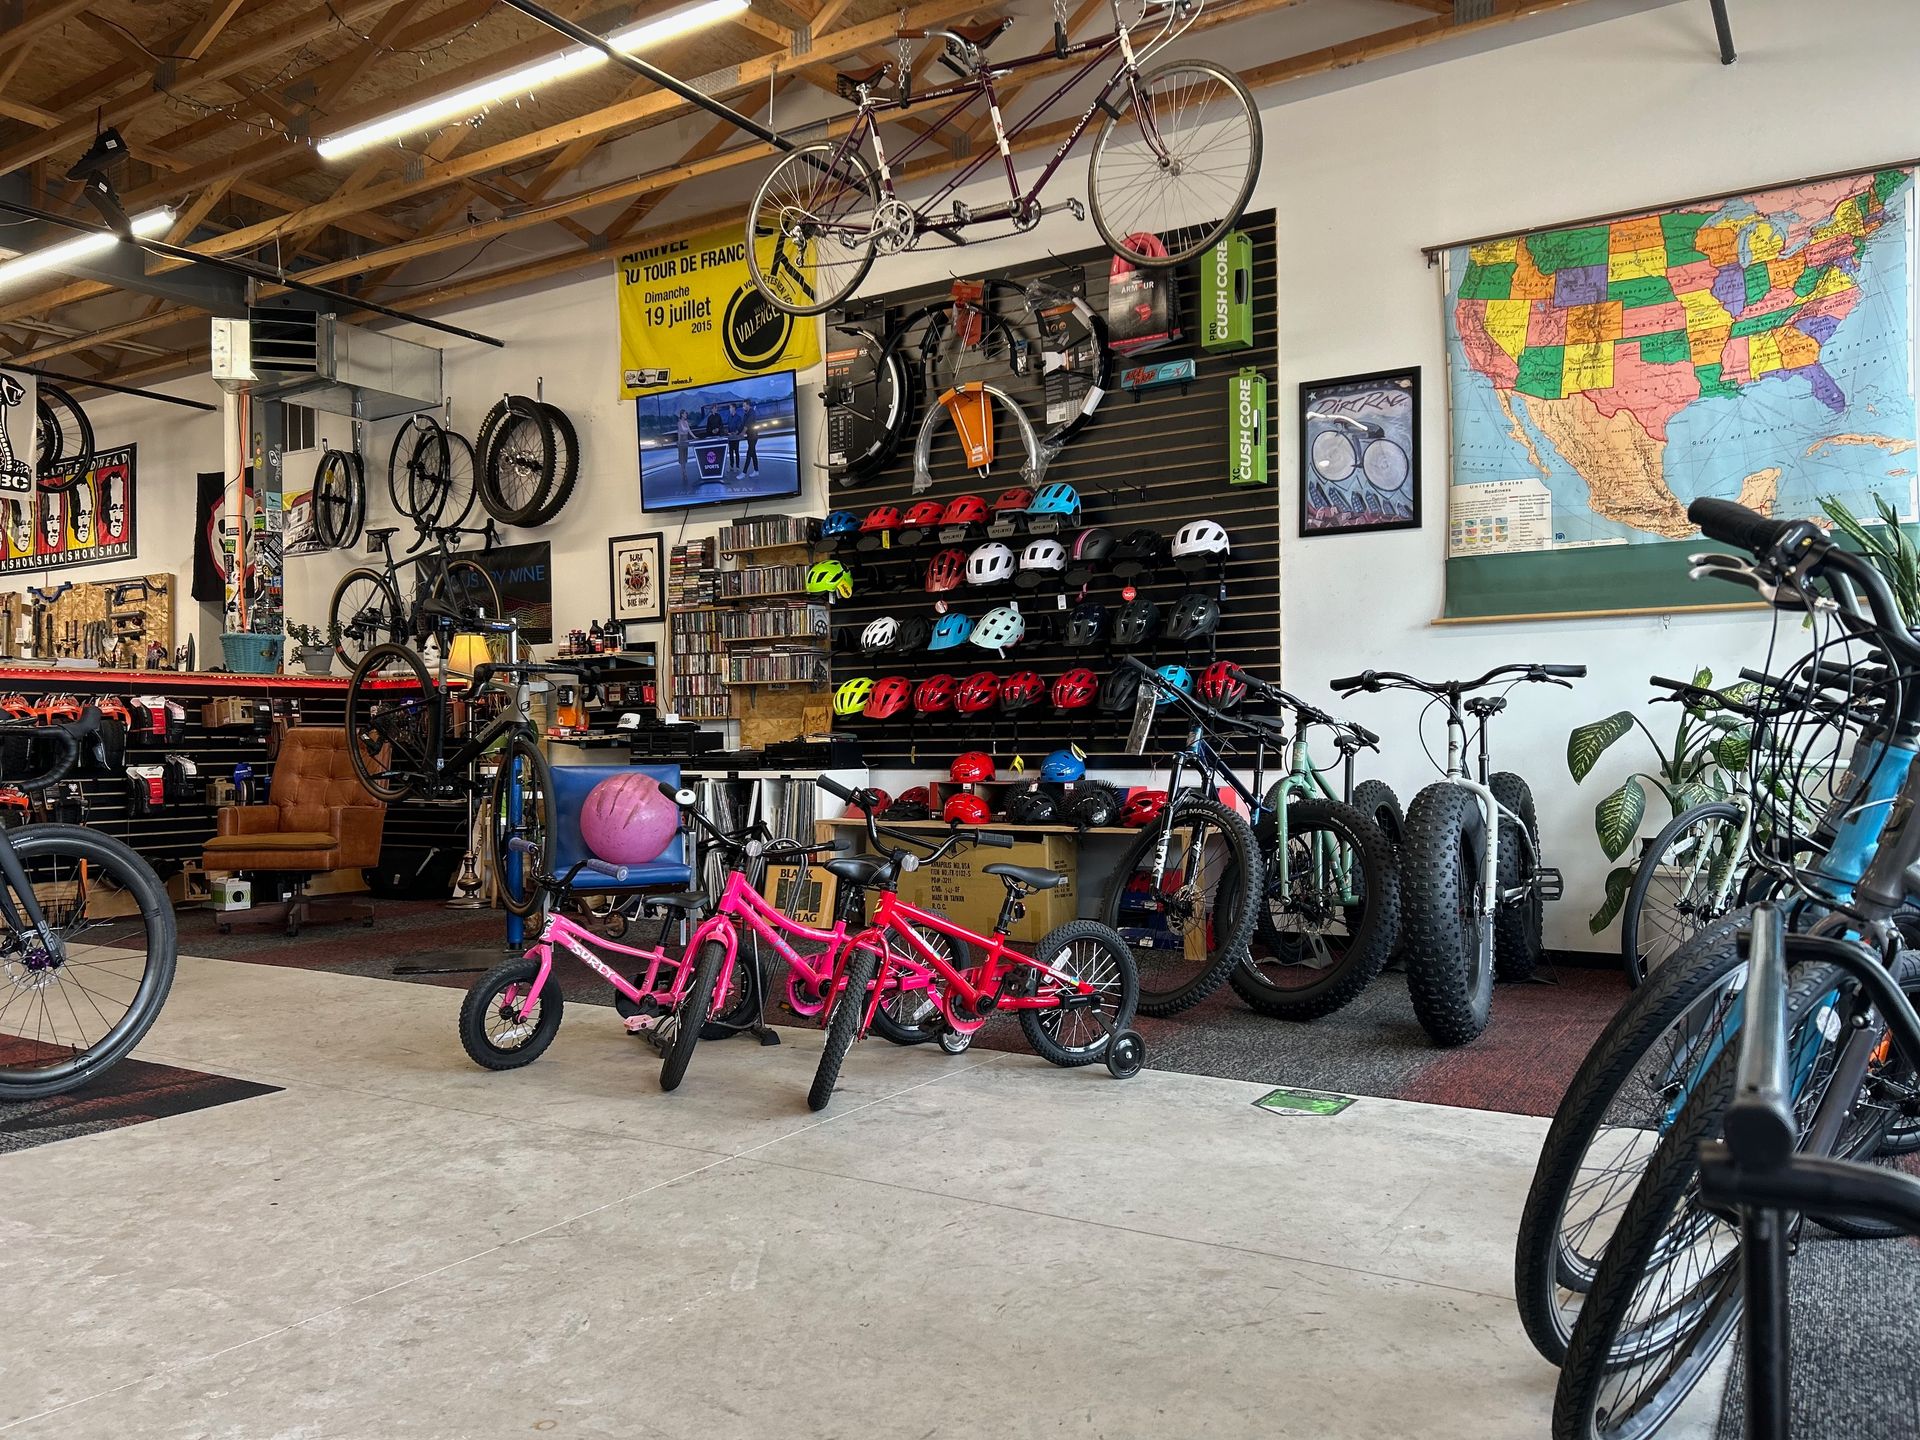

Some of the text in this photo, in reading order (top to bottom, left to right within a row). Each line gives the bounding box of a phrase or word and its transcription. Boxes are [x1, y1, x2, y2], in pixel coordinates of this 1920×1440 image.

[643, 260, 677, 282] TOUR
[680, 255, 697, 274] DE
[700, 243, 745, 269] FRANC
[644, 286, 690, 304] Dimanche
[1216, 240, 1229, 339] CUSH CORE
[645, 296, 711, 328] 19 juillet
[1688, 313, 1720, 324] Missouri
[691, 320, 712, 334] 2015
[736, 304, 780, 344] VALENCE
[1209, 322, 1218, 341] PRO
[1841, 355, 1888, 375] Ocean
[1239, 379, 1252, 480] CUSH CORE
[1691, 437, 1717, 447] Gulf
[1753, 423, 1794, 436] Mexico
[98, 453, 128, 468] HEAD
[1232, 467, 1241, 480] XC
[9, 557, 35, 570] SHOK
[37, 553, 65, 565] SHOK
[67, 547, 96, 561] SHOK
[99, 542, 129, 557] SHOK
[510, 564, 545, 584] NINE
[1188, 808, 1218, 820] MAZZA
[780, 868, 813, 879] BLAK
